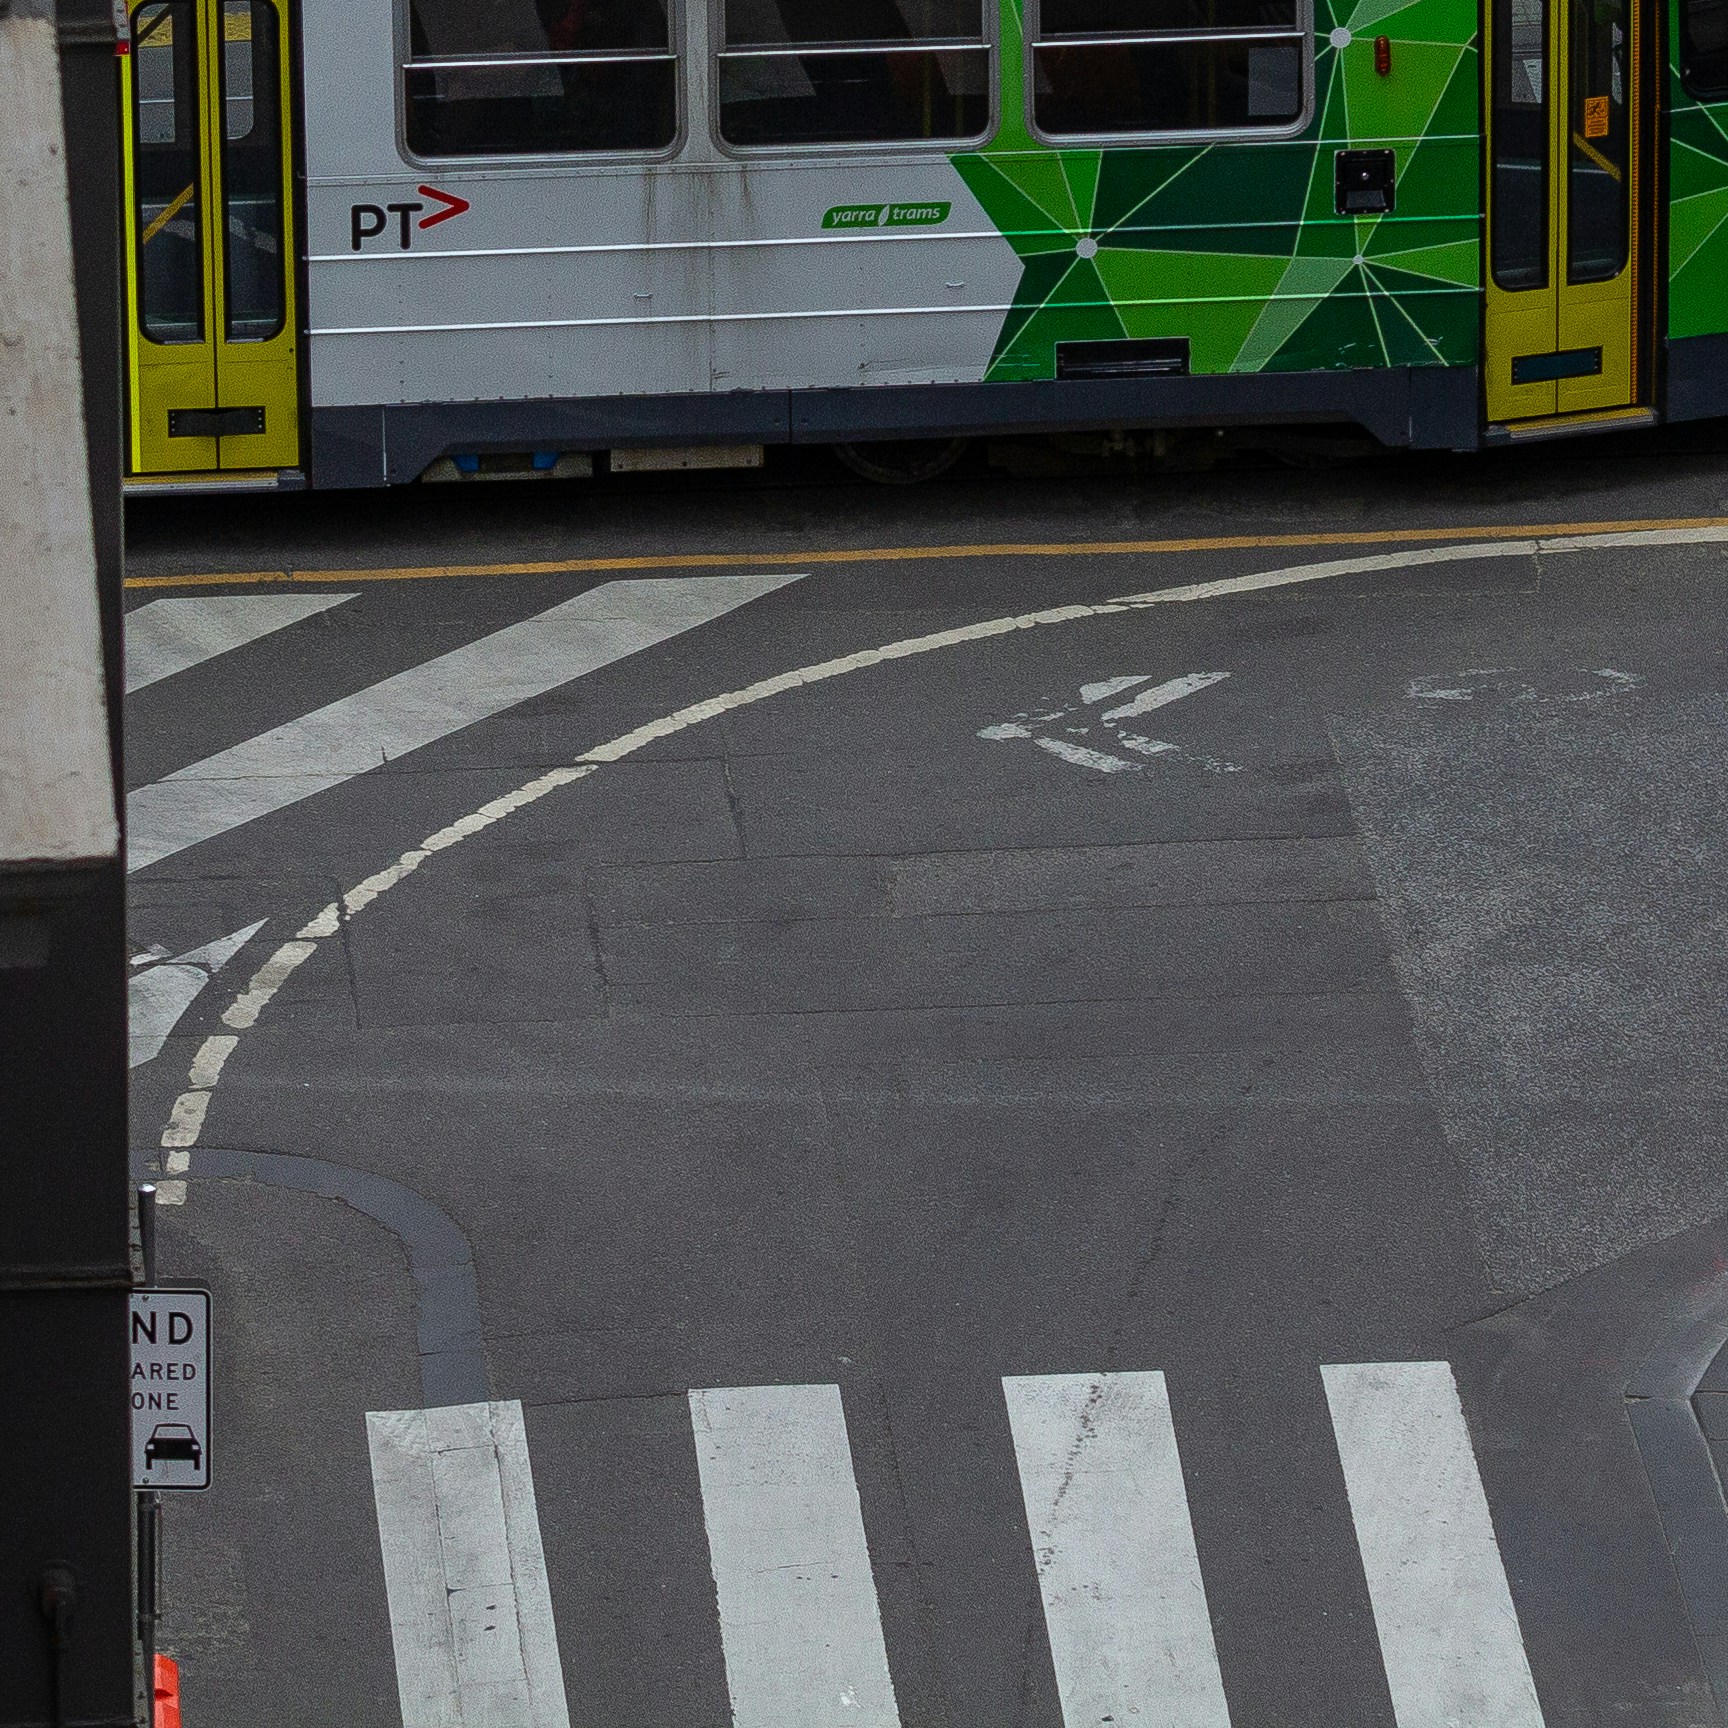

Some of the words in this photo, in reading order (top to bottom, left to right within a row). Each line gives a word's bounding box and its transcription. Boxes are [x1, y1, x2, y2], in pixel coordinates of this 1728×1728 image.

[351, 202, 424, 252] PT
[831, 206, 876, 228] yarra
[891, 202, 942, 223] trams
